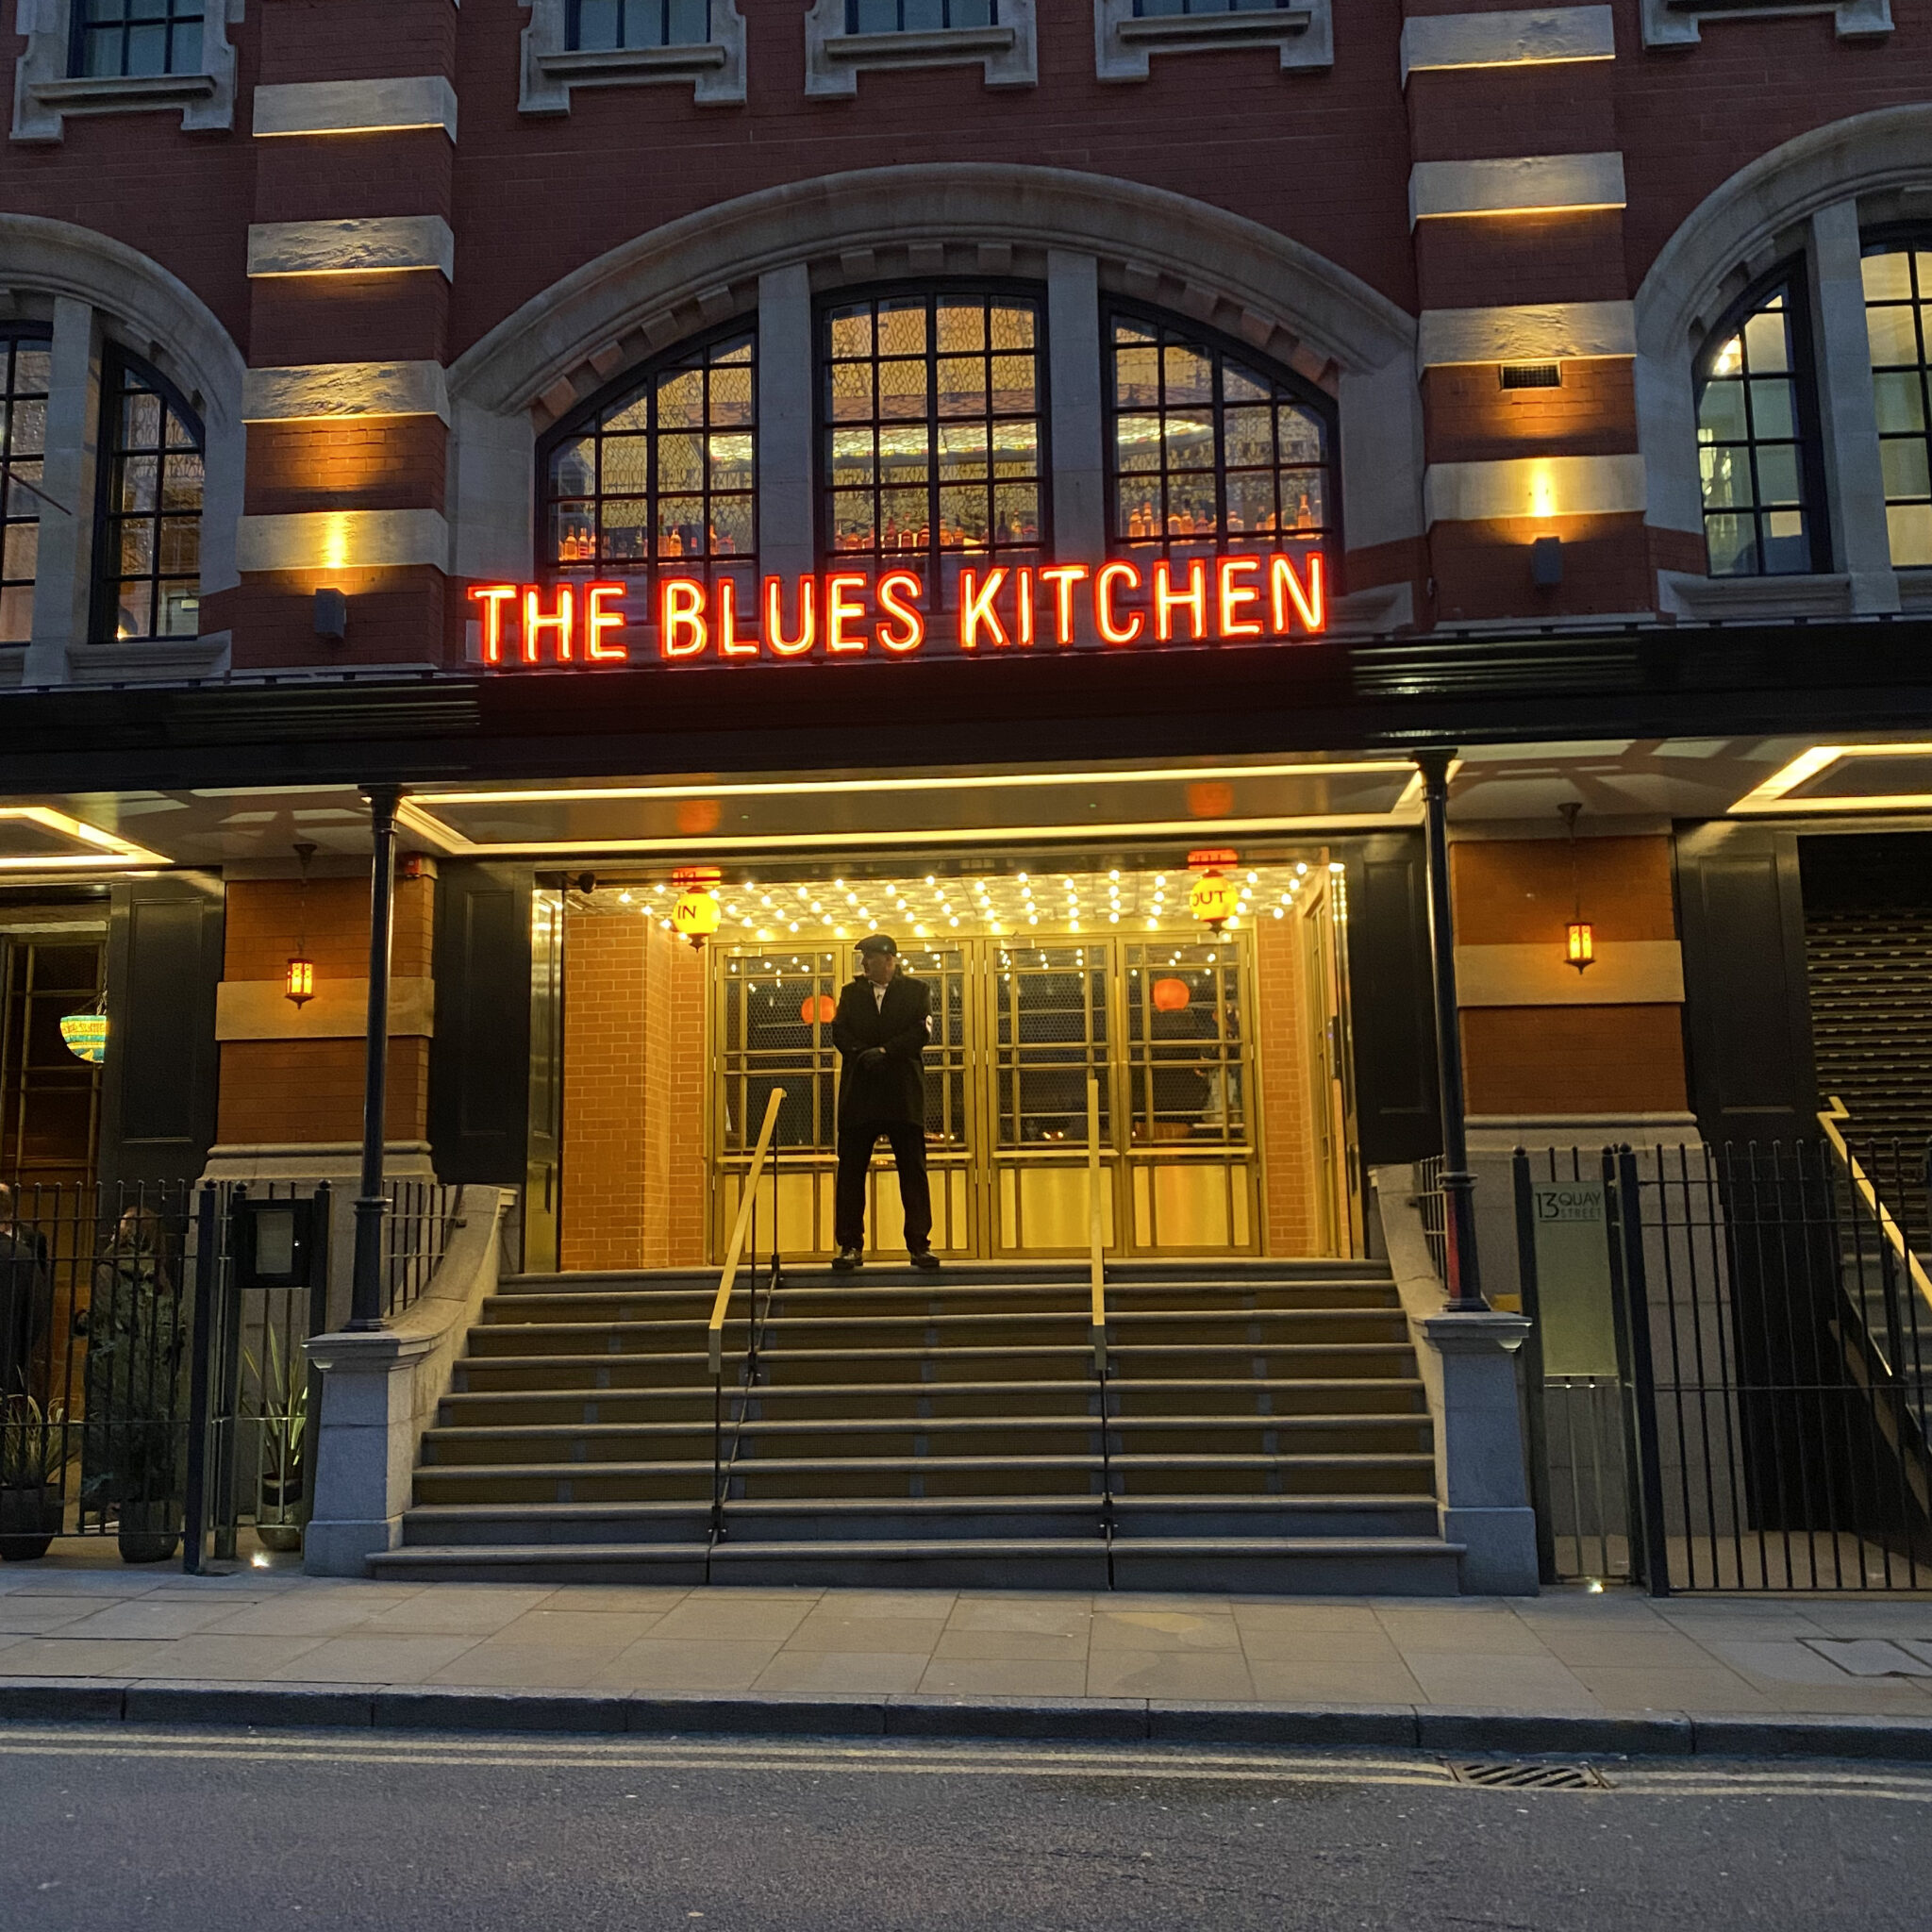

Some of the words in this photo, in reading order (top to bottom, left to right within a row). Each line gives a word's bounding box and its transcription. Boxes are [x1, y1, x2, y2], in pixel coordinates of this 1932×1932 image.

[468, 582, 626, 662] THE
[660, 570, 925, 660] BLUES
[958, 551, 1326, 649] KITCHEN
[677, 905, 696, 920] IN
[1535, 1191, 1559, 1219] 13
[1558, 1191, 1602, 1207] QUAY
[1561, 1208, 1602, 1219] STREET
